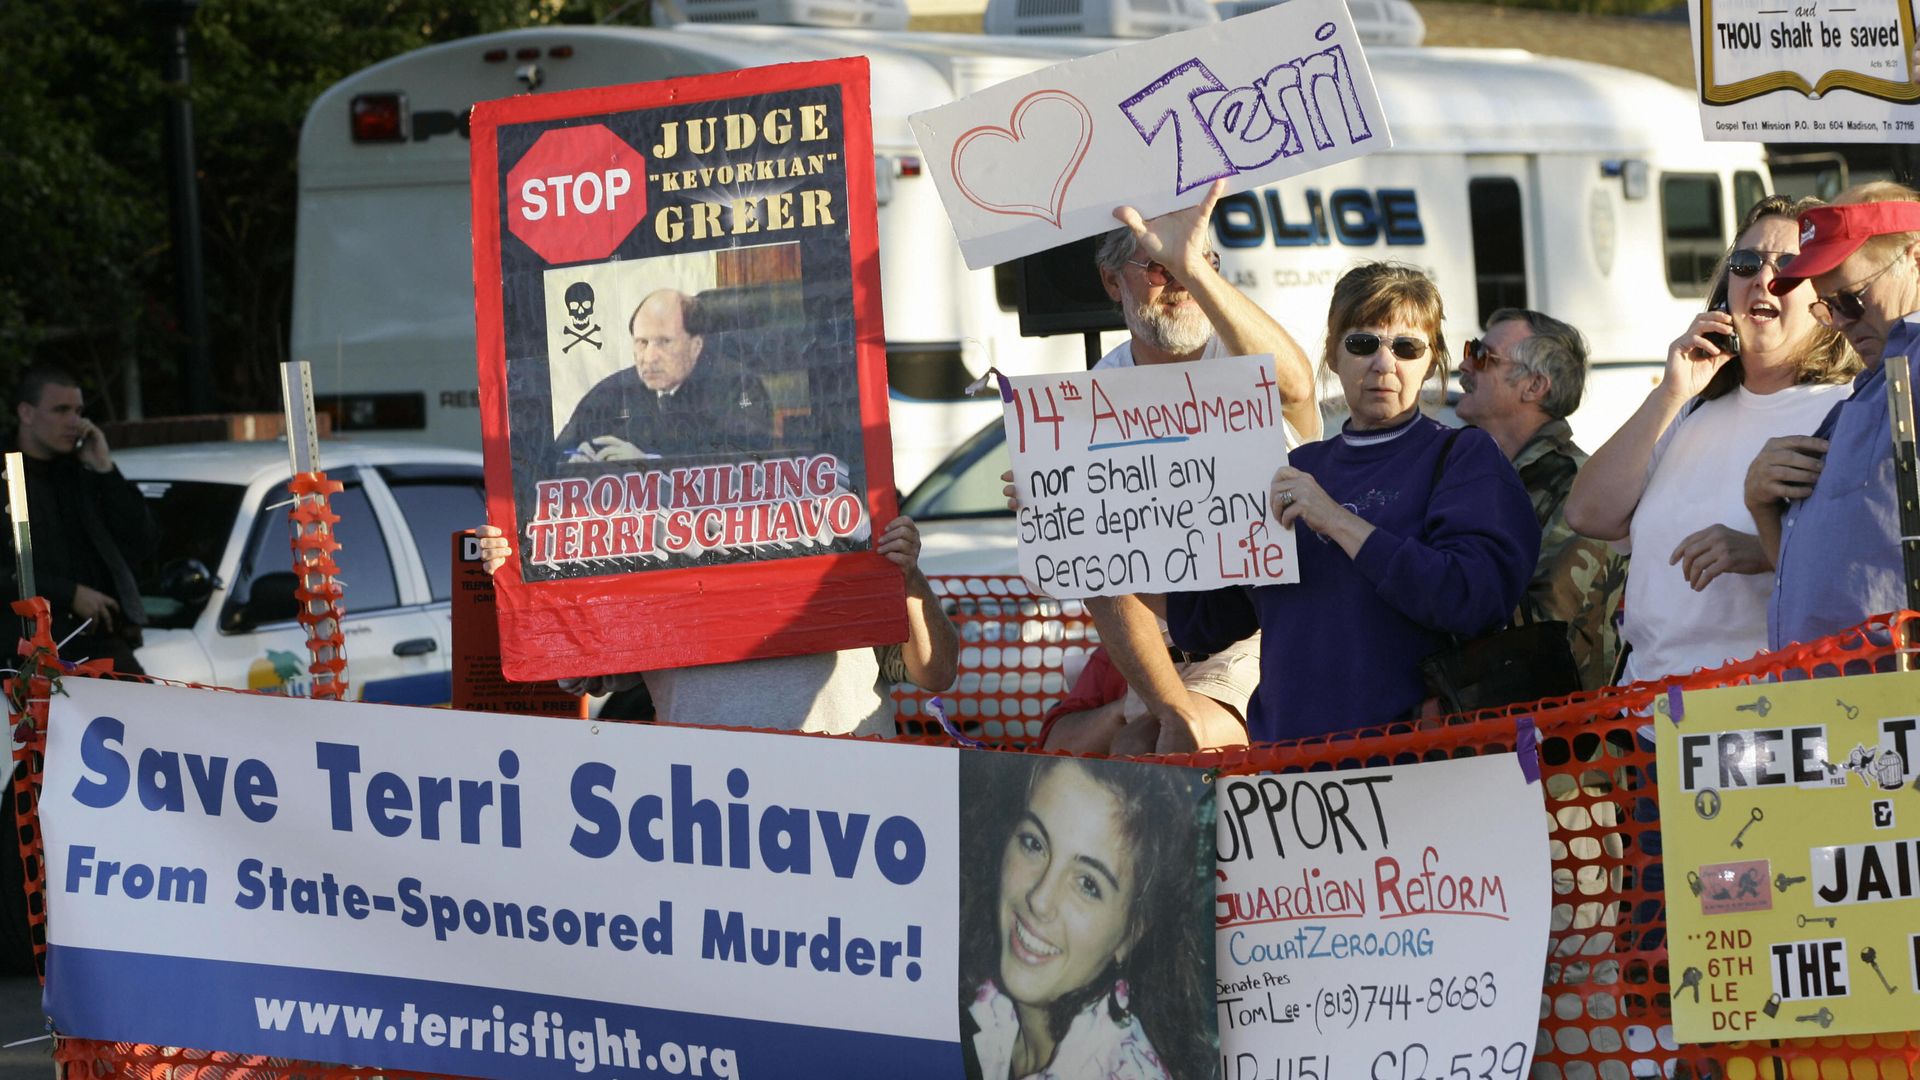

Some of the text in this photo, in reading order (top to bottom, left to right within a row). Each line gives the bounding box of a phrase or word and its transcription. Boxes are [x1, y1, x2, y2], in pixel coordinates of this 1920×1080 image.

[1717, 19, 1899, 49] THOU shalt be saved
[1795, 0, 1817, 17] and
[652, 104, 830, 159] JUDGE
[1119, 22, 1371, 196] Terri
[1716, 121, 1739, 131] Gospel
[1742, 121, 1758, 130] Text
[1761, 121, 1791, 130] Mission
[1813, 121, 1826, 130] Box
[1829, 121, 1844, 130] 604
[521, 168, 631, 221] STOP
[649, 153, 838, 192] "KEVORKIAN"
[654, 190, 836, 243] GREER
[1212, 188, 1425, 248] OLICE
[1012, 380, 1082, 453] 14th
[535, 454, 841, 522] FROM KILLING
[1031, 466, 1075, 498] nor
[1169, 457, 1215, 504] any
[526, 494, 863, 566] TERRI SCHIAVO
[1096, 497, 1194, 543] deprive
[1208, 490, 1267, 540] any
[1165, 529, 1205, 583] of
[1217, 521, 1283, 579] Life
[1682, 727, 1824, 790] FREE
[1830, 777, 1846, 786] FREE
[72, 716, 926, 886] Save Terri Schiavo
[1216, 775, 1393, 862] UPPORT
[1818, 841, 1920, 903] JAI
[65, 844, 922, 982] From State-Sponsored Murder!
[1708, 956, 1753, 977] 6TH
[1711, 982, 1739, 1003] LE
[1772, 941, 1847, 999] THE
[254, 997, 740, 1080] www.terrisfight.org
[1712, 1010, 1758, 1031] DCF
